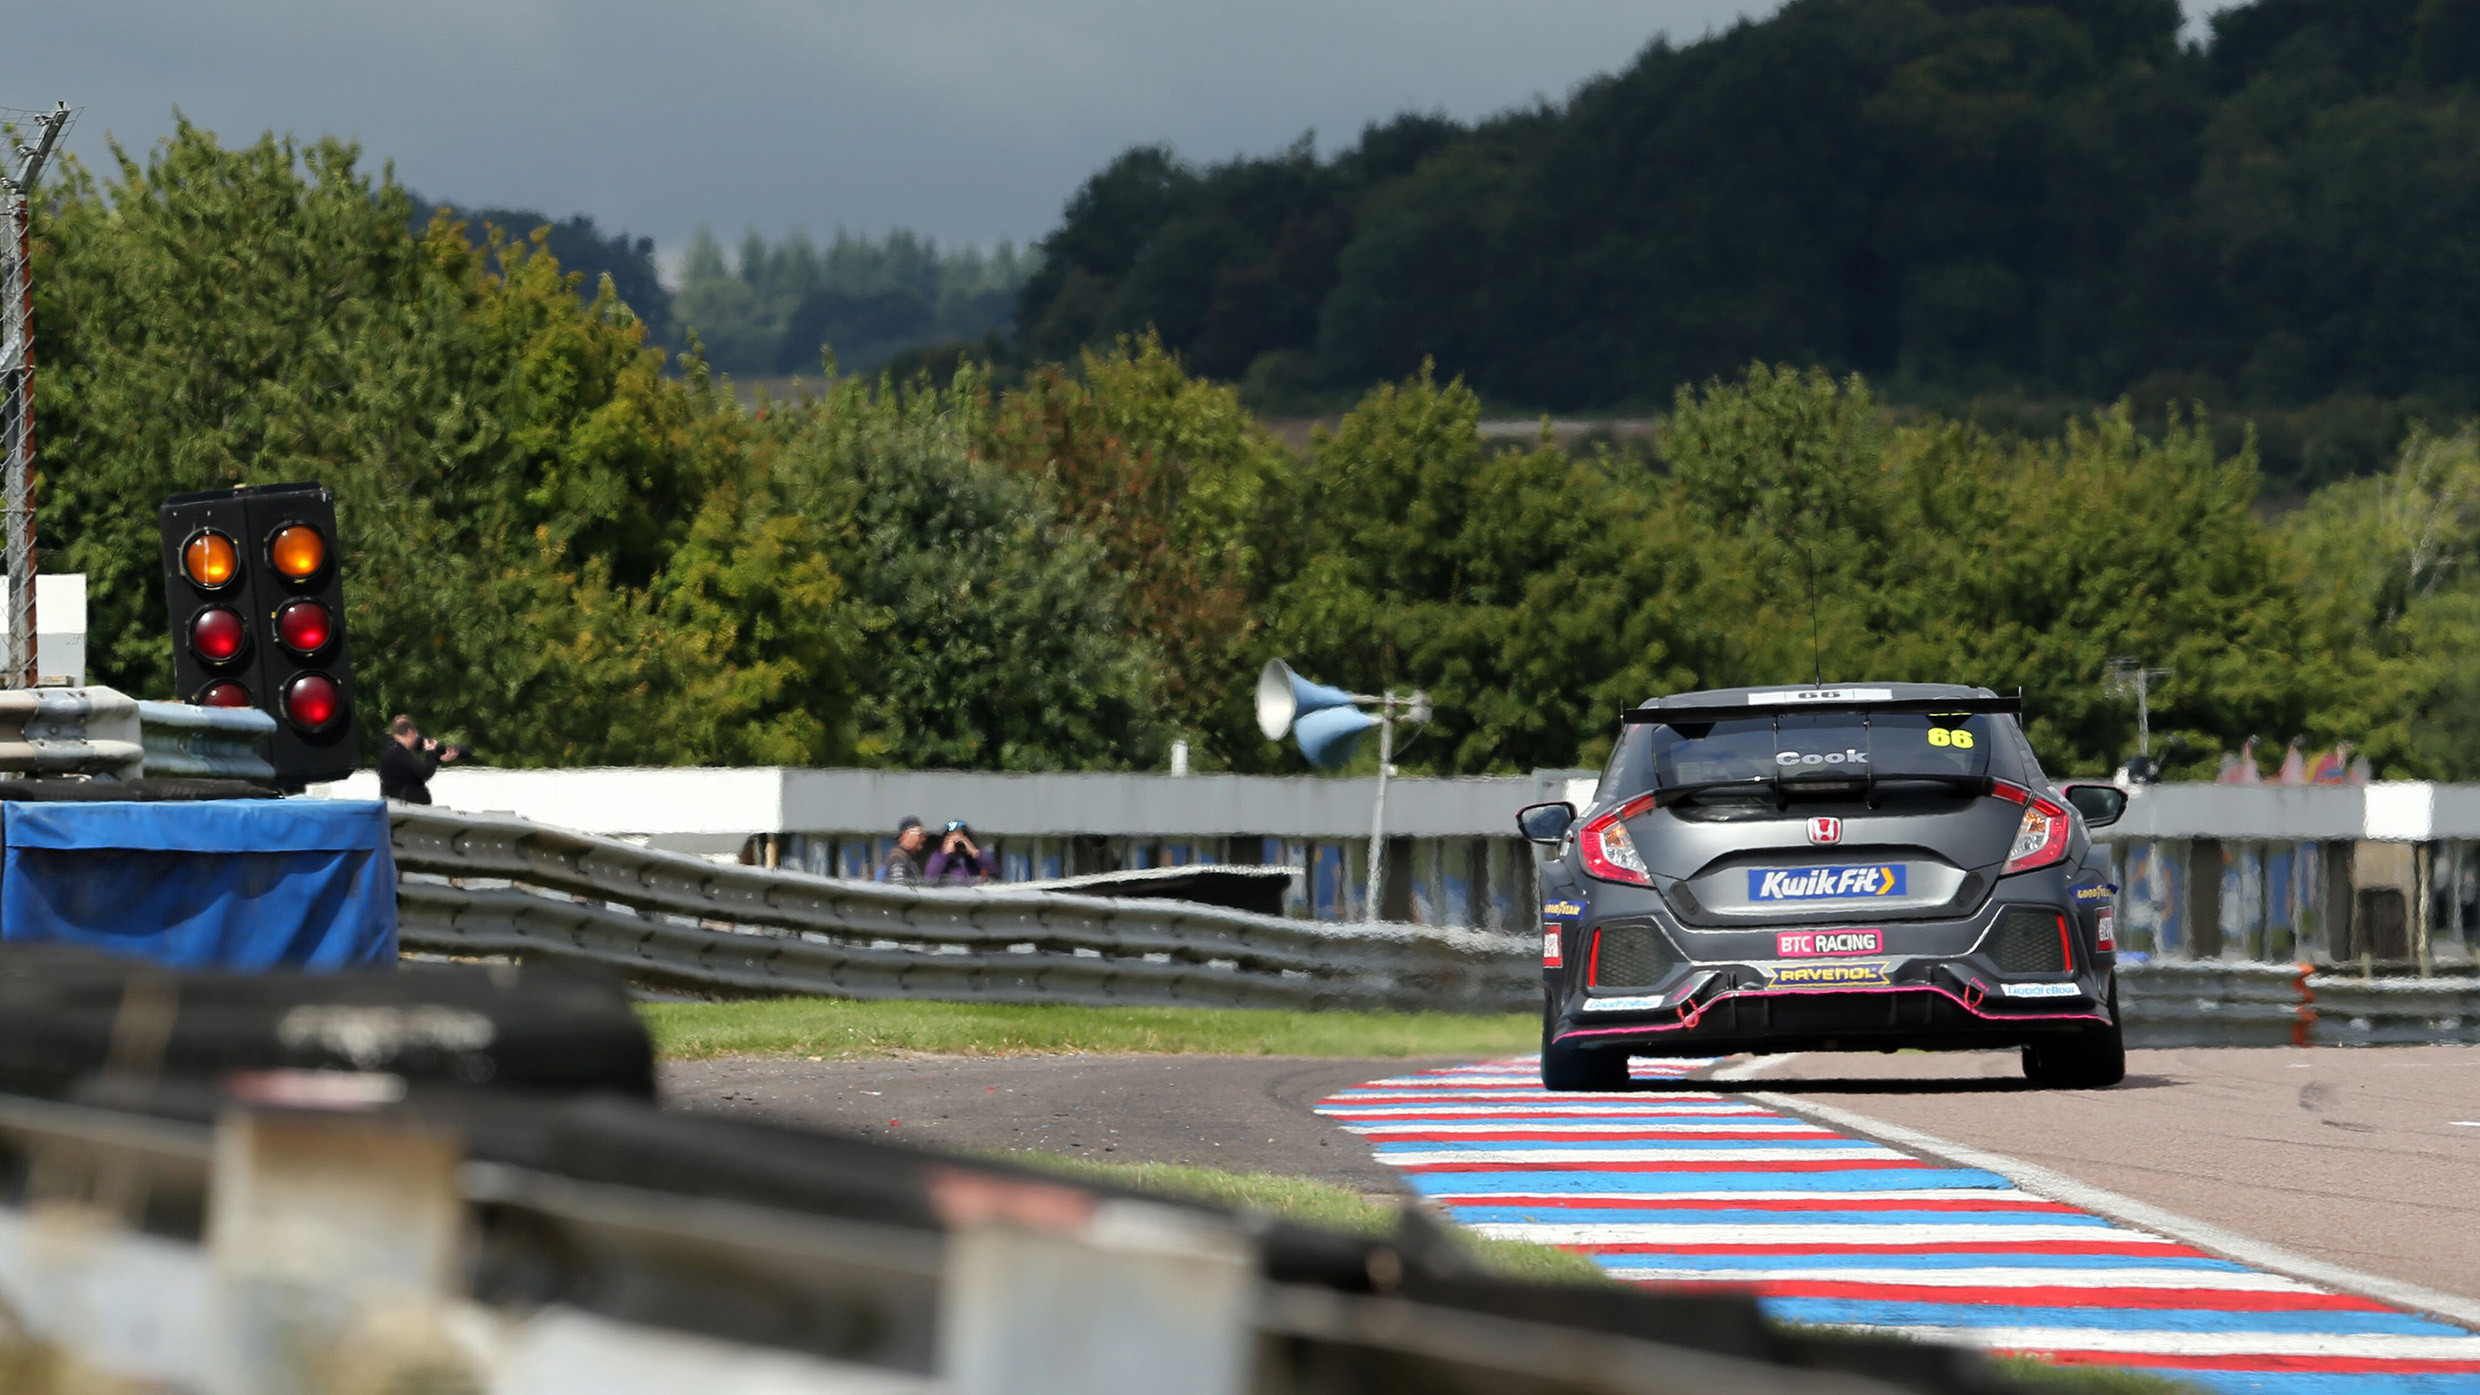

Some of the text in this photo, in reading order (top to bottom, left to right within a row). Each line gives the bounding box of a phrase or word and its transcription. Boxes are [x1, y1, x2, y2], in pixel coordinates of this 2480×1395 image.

[1928, 727, 1974, 749] 66
[1776, 749, 1869, 766] Cook
[1780, 934, 1876, 952] BTC RACING
